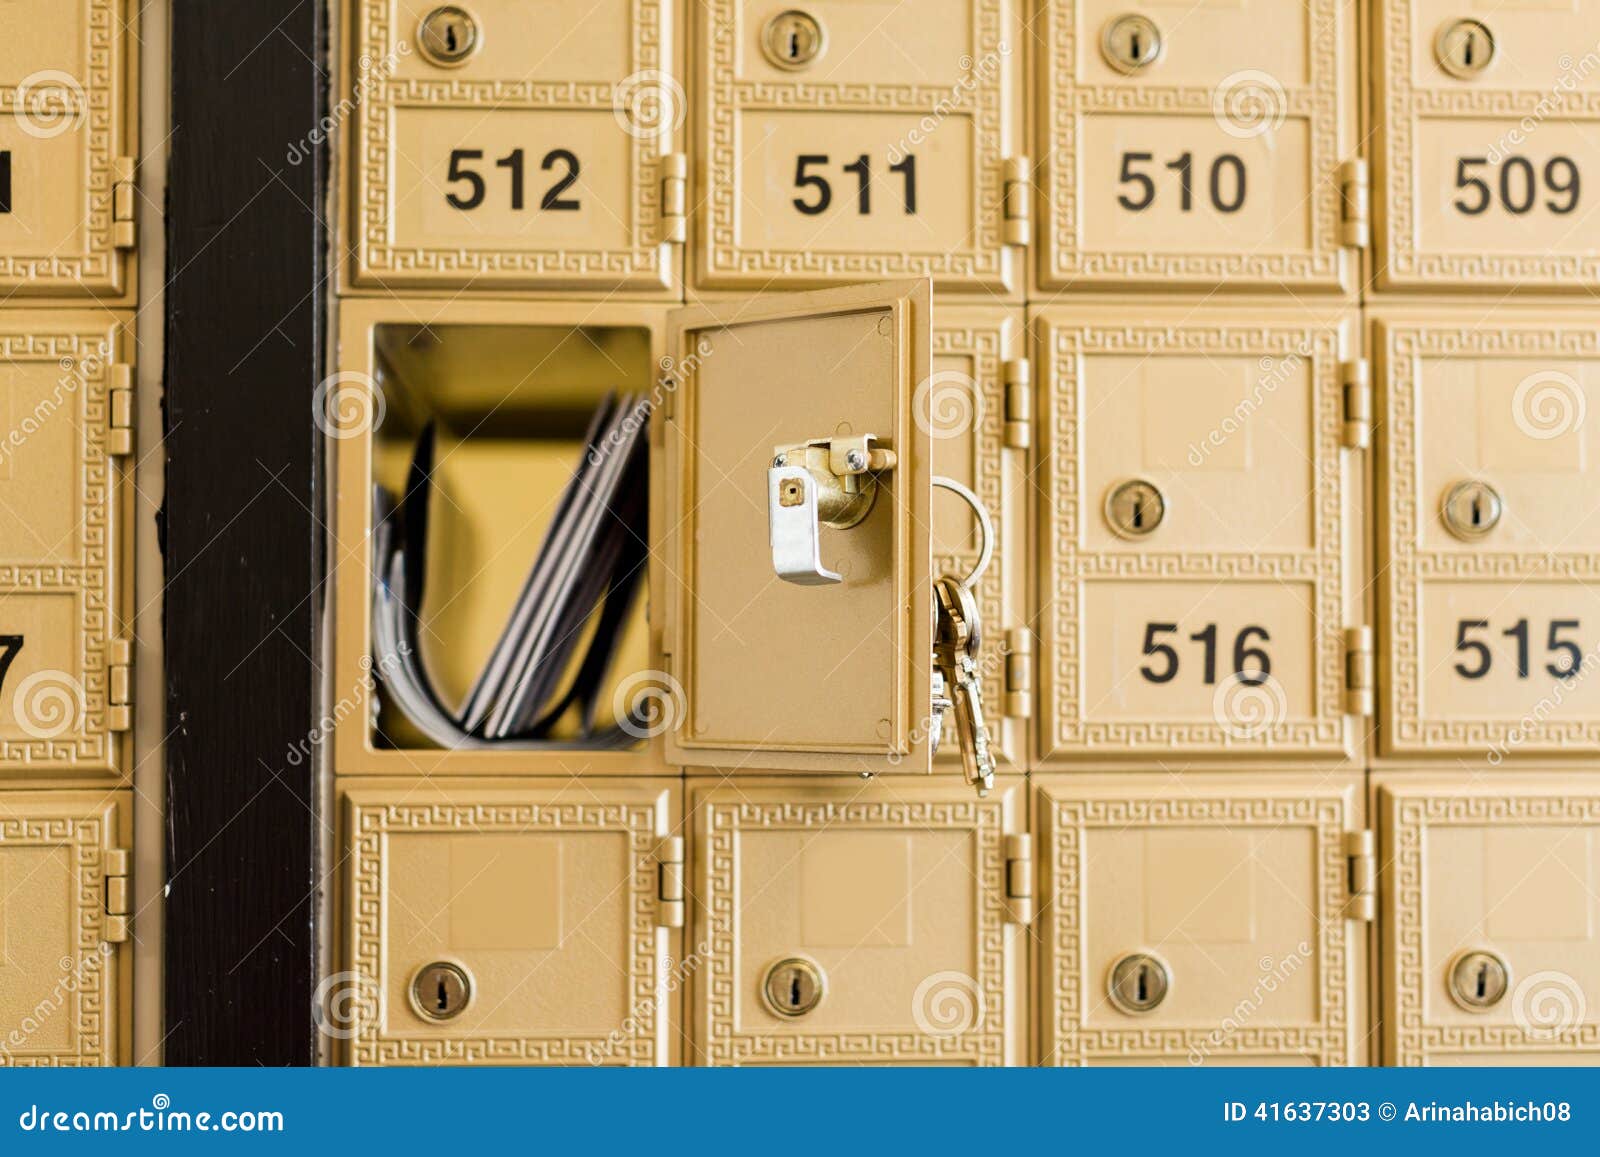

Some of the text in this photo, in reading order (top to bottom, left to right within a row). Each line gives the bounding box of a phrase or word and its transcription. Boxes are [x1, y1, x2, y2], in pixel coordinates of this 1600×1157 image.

[445, 148, 581, 211] 512
[792, 154, 917, 216] 511
[1117, 152, 1247, 214] 510
[1454, 155, 1581, 216] 509
[1139, 621, 1272, 687] 516
[1454, 618, 1583, 680] 515
